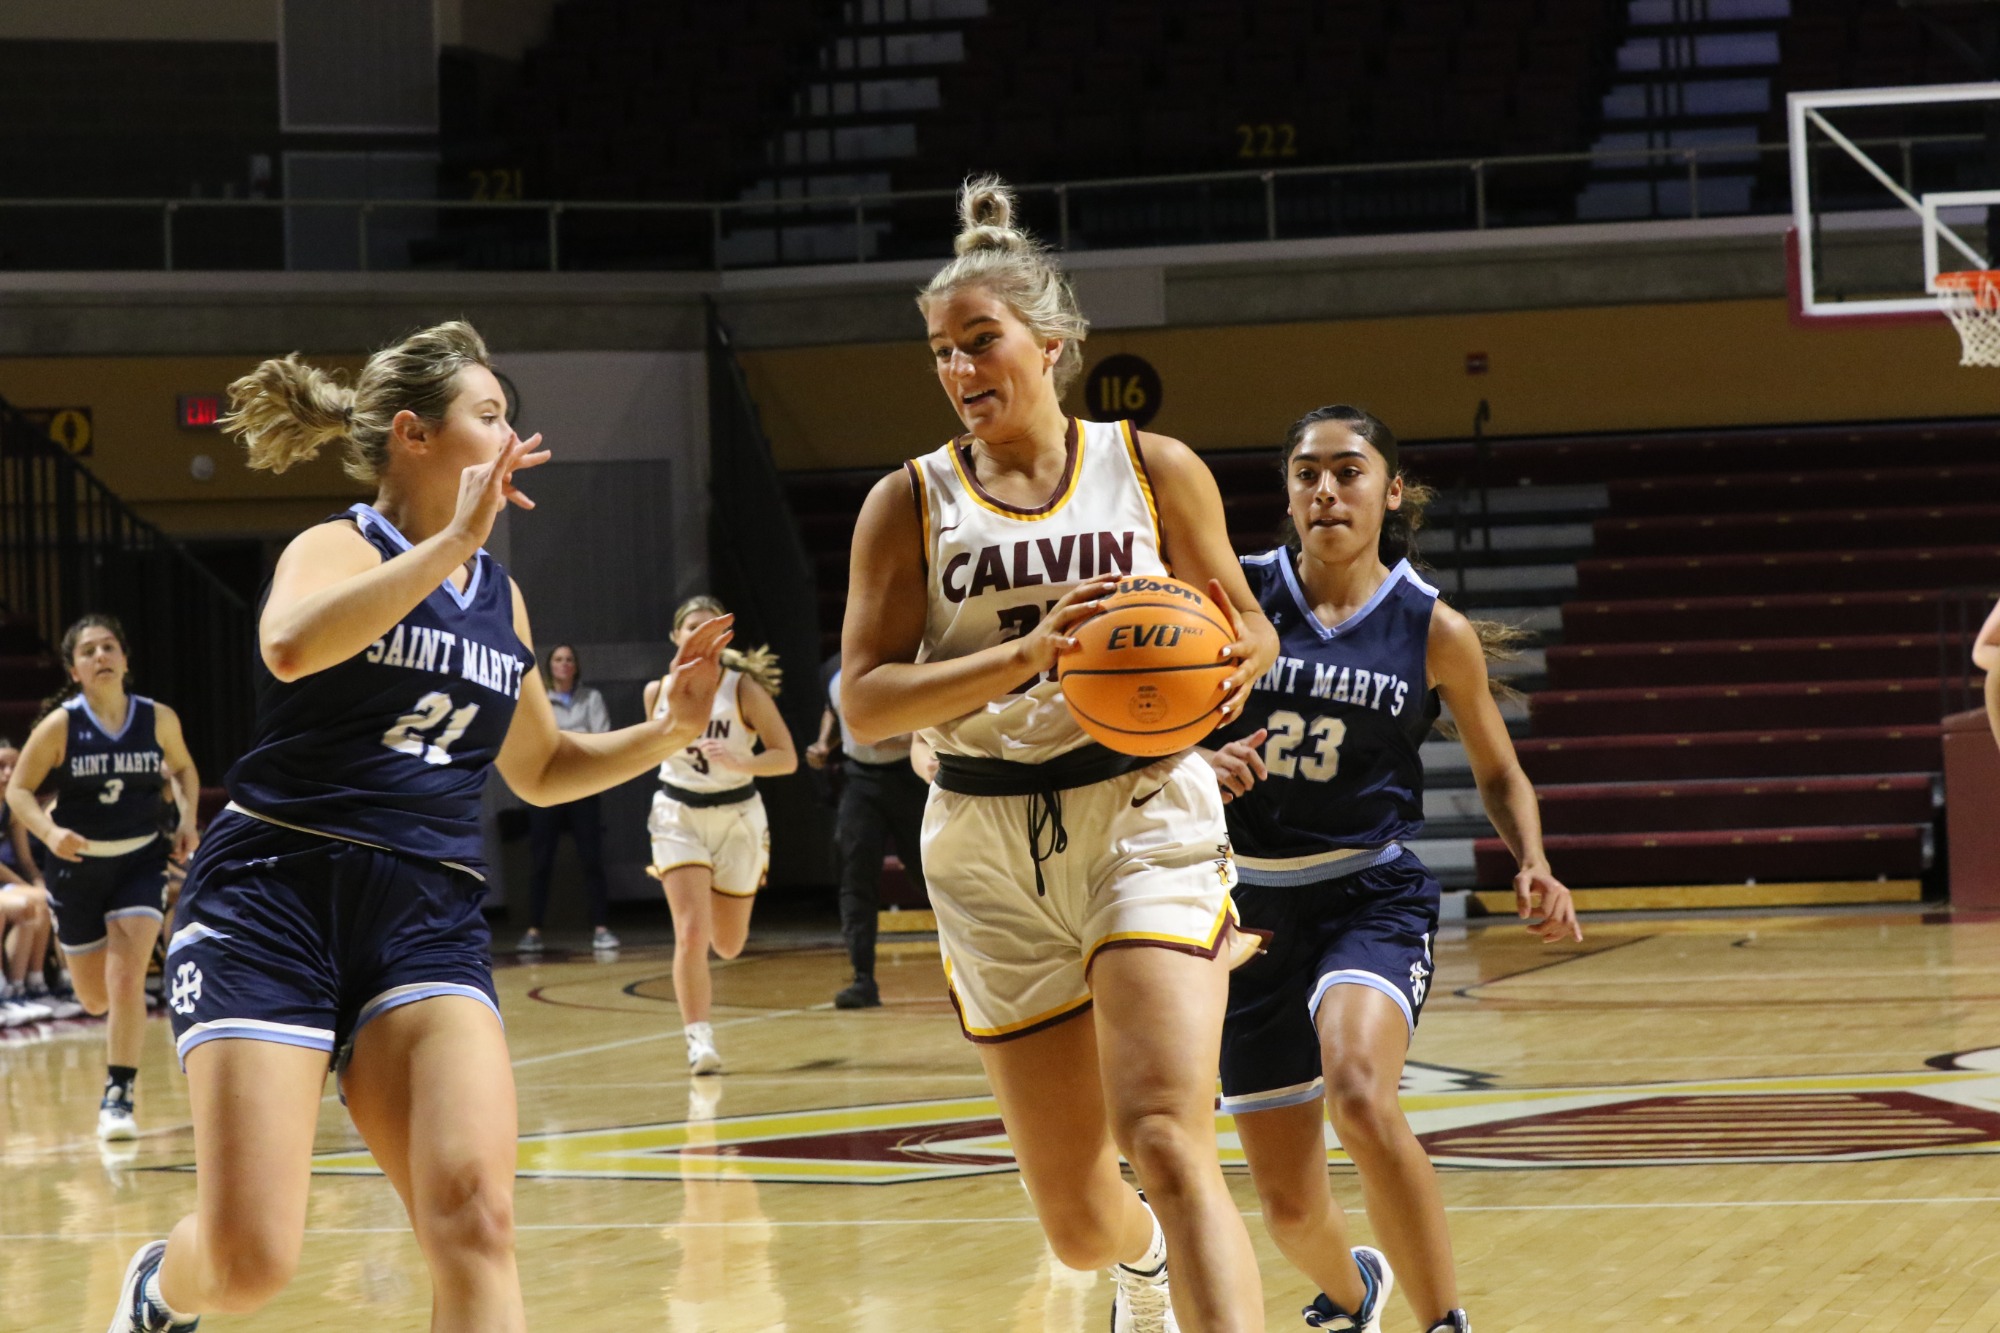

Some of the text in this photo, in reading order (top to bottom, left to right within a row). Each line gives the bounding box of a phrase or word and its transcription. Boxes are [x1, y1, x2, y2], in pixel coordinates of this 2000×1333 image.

[1235, 123, 1297, 157] 222
[468, 167, 523, 201] 221
[1101, 374, 1147, 411] 116
[942, 531, 1134, 603] CALVIN
[1100, 578, 1202, 605] ilson
[1108, 624, 1182, 650] EVO
[366, 623, 525, 701] SAINT MARY'S
[1254, 655, 1409, 717] NT MARY'S
[381, 691, 480, 765] 21
[697, 720, 731, 739] IN
[685, 746, 709, 775] 3
[1264, 709, 1347, 783] 23
[71, 751, 160, 778] SAINT MARY'S
[98, 778, 124, 804] 3
